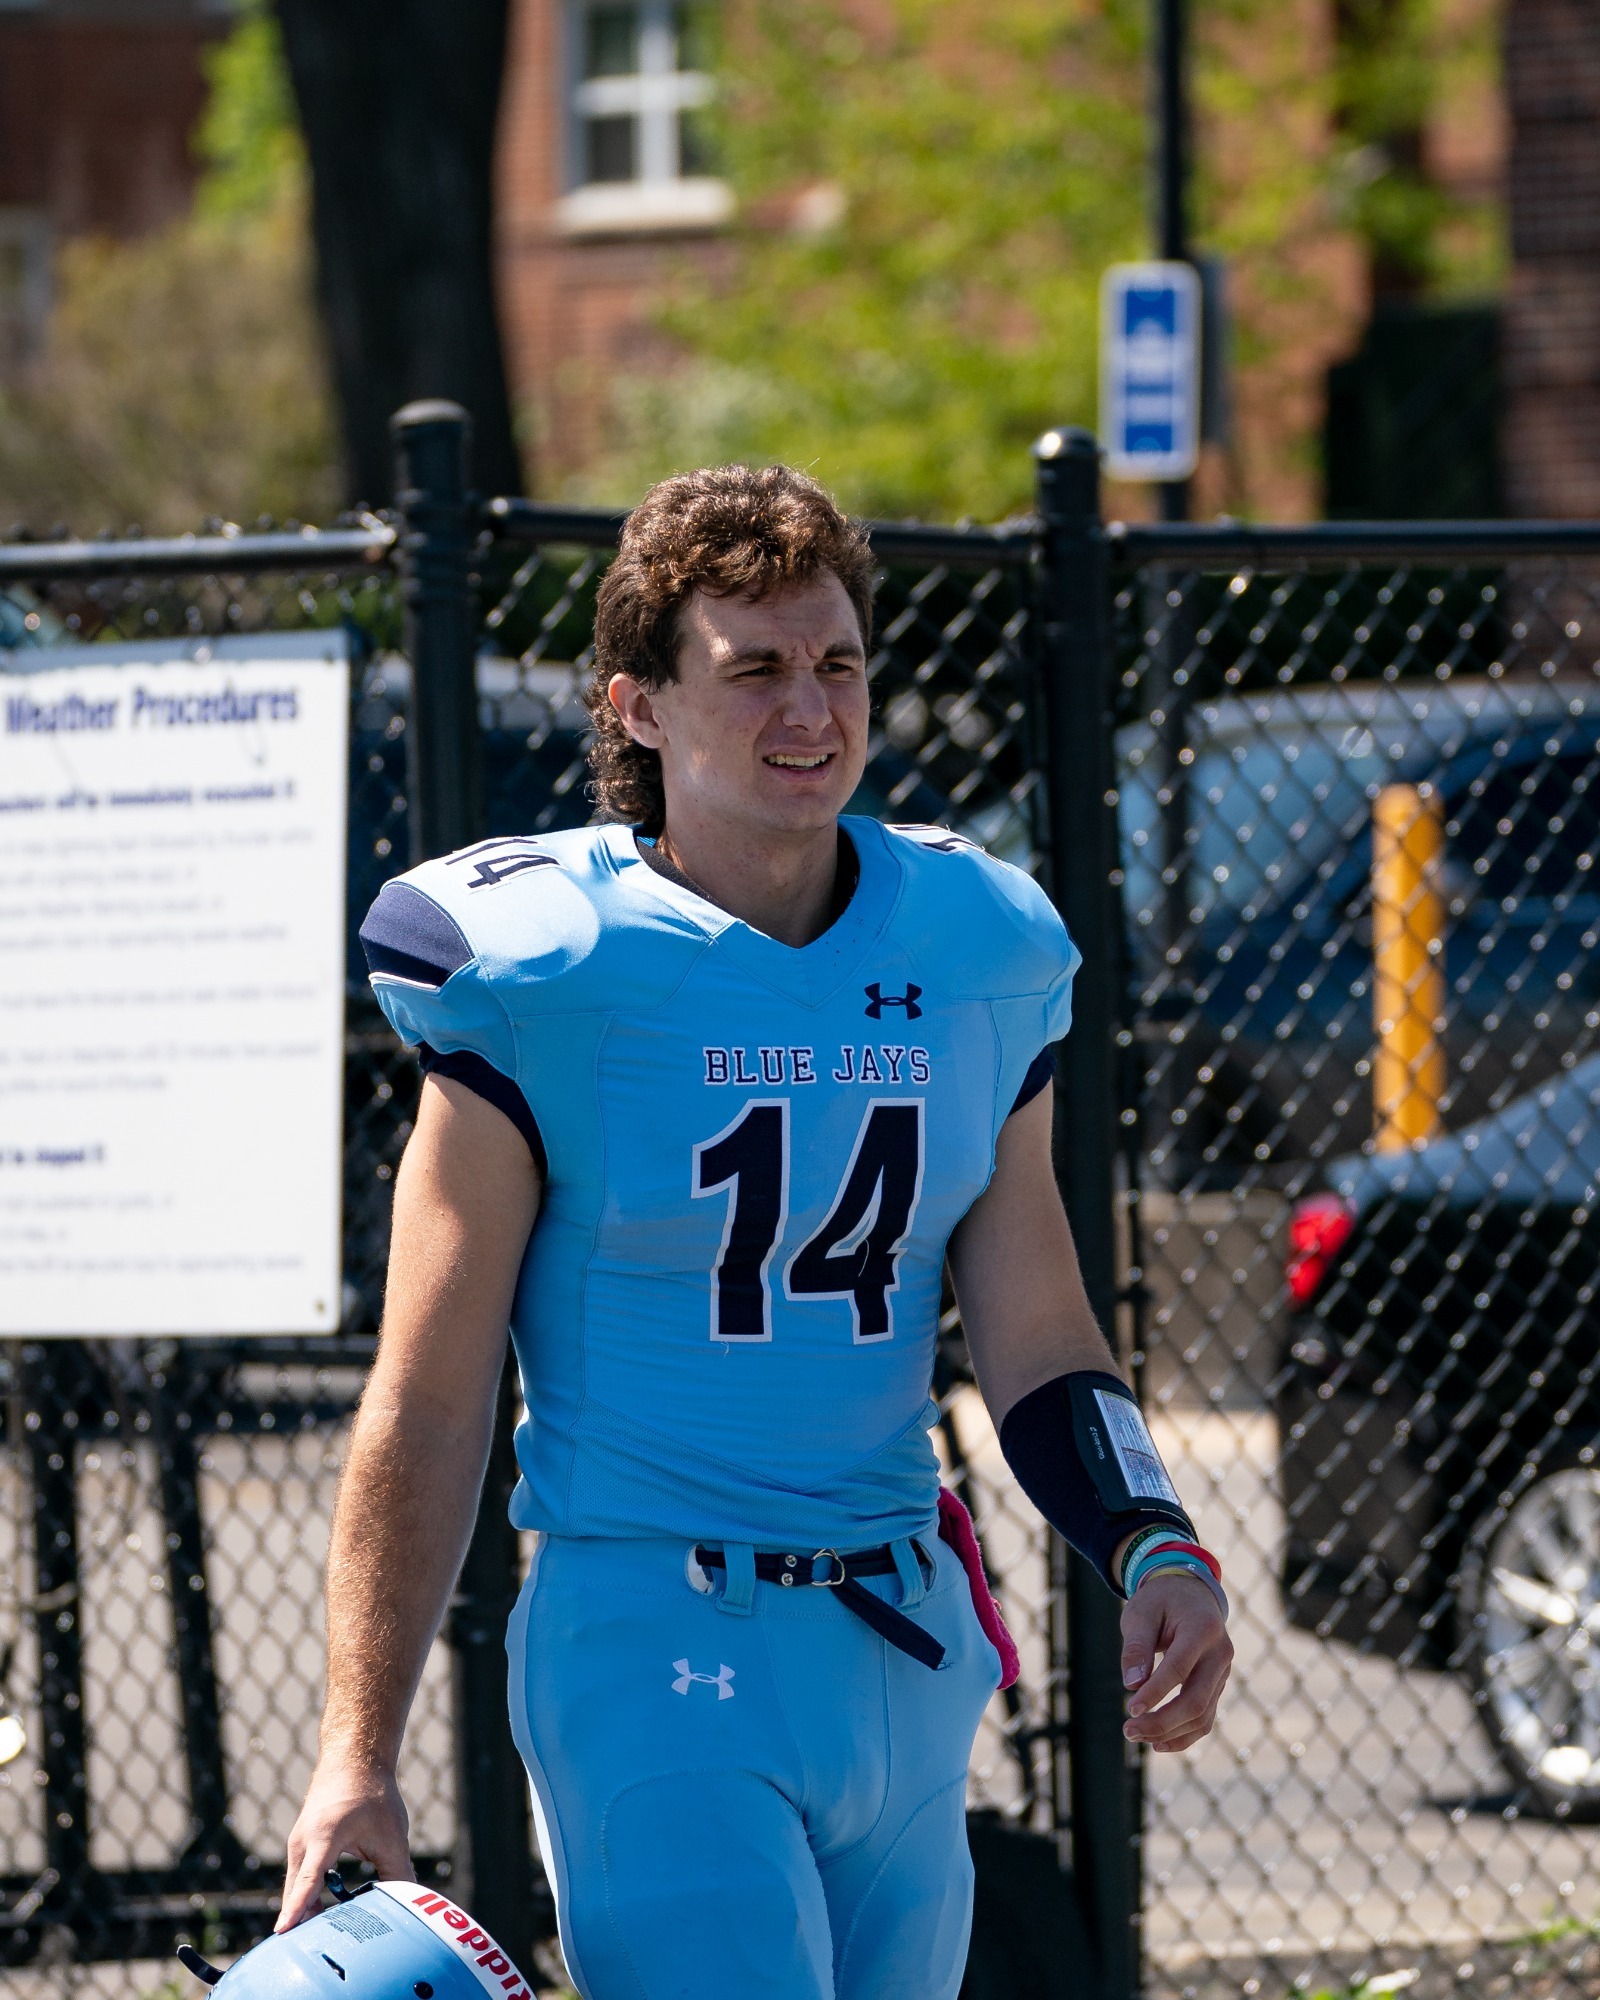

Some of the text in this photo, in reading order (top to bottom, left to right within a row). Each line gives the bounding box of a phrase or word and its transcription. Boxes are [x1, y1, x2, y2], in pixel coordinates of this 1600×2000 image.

[6, 686, 298, 732] Weather Procedures
[445, 837, 561, 889] 14
[703, 1045, 930, 1085] BLUE JAYS
[691, 1097, 926, 1345] 14
